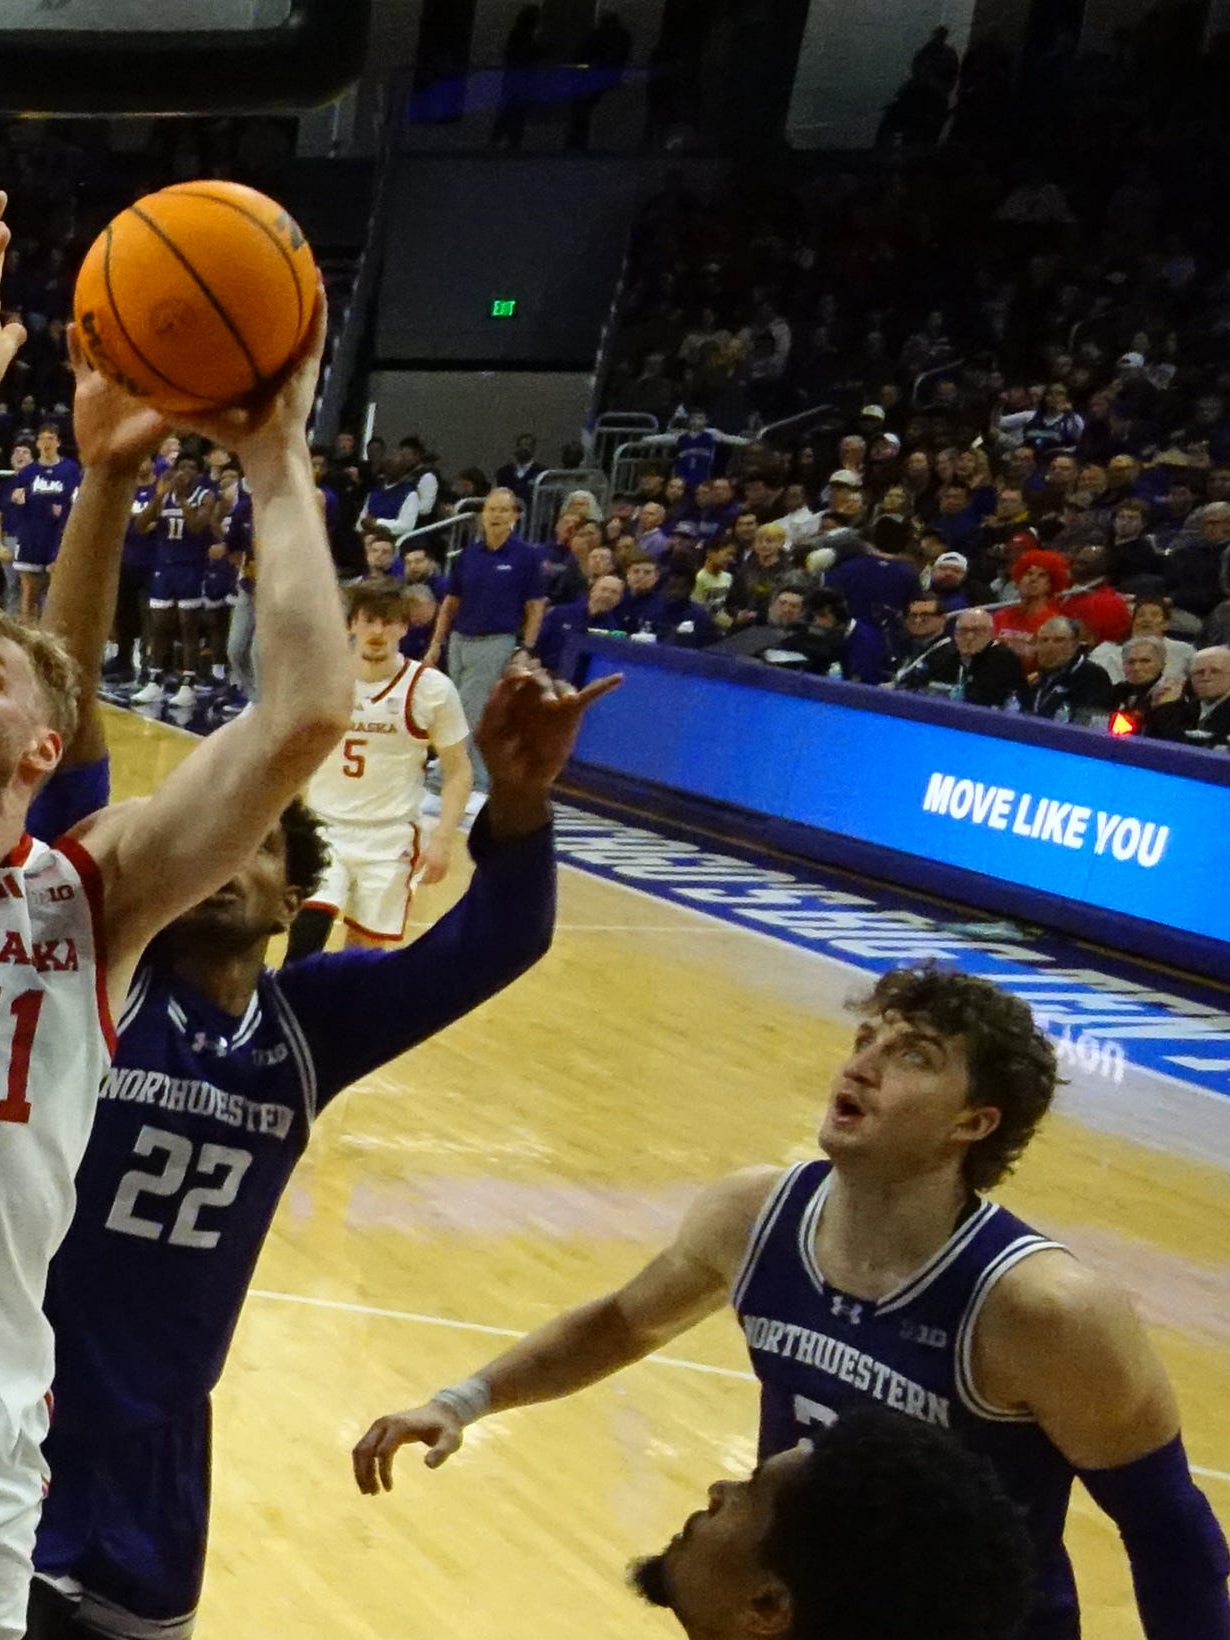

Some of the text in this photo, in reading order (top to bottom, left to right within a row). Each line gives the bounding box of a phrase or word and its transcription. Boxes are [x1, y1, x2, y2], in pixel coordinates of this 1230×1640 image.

[169, 518, 185, 540] 11
[343, 739, 368, 779] 5
[923, 772, 1170, 868] MOVE LIKE YOU
[105, 1124, 253, 1249] 22
[744, 1314, 950, 1429] NORTHWESTERN
